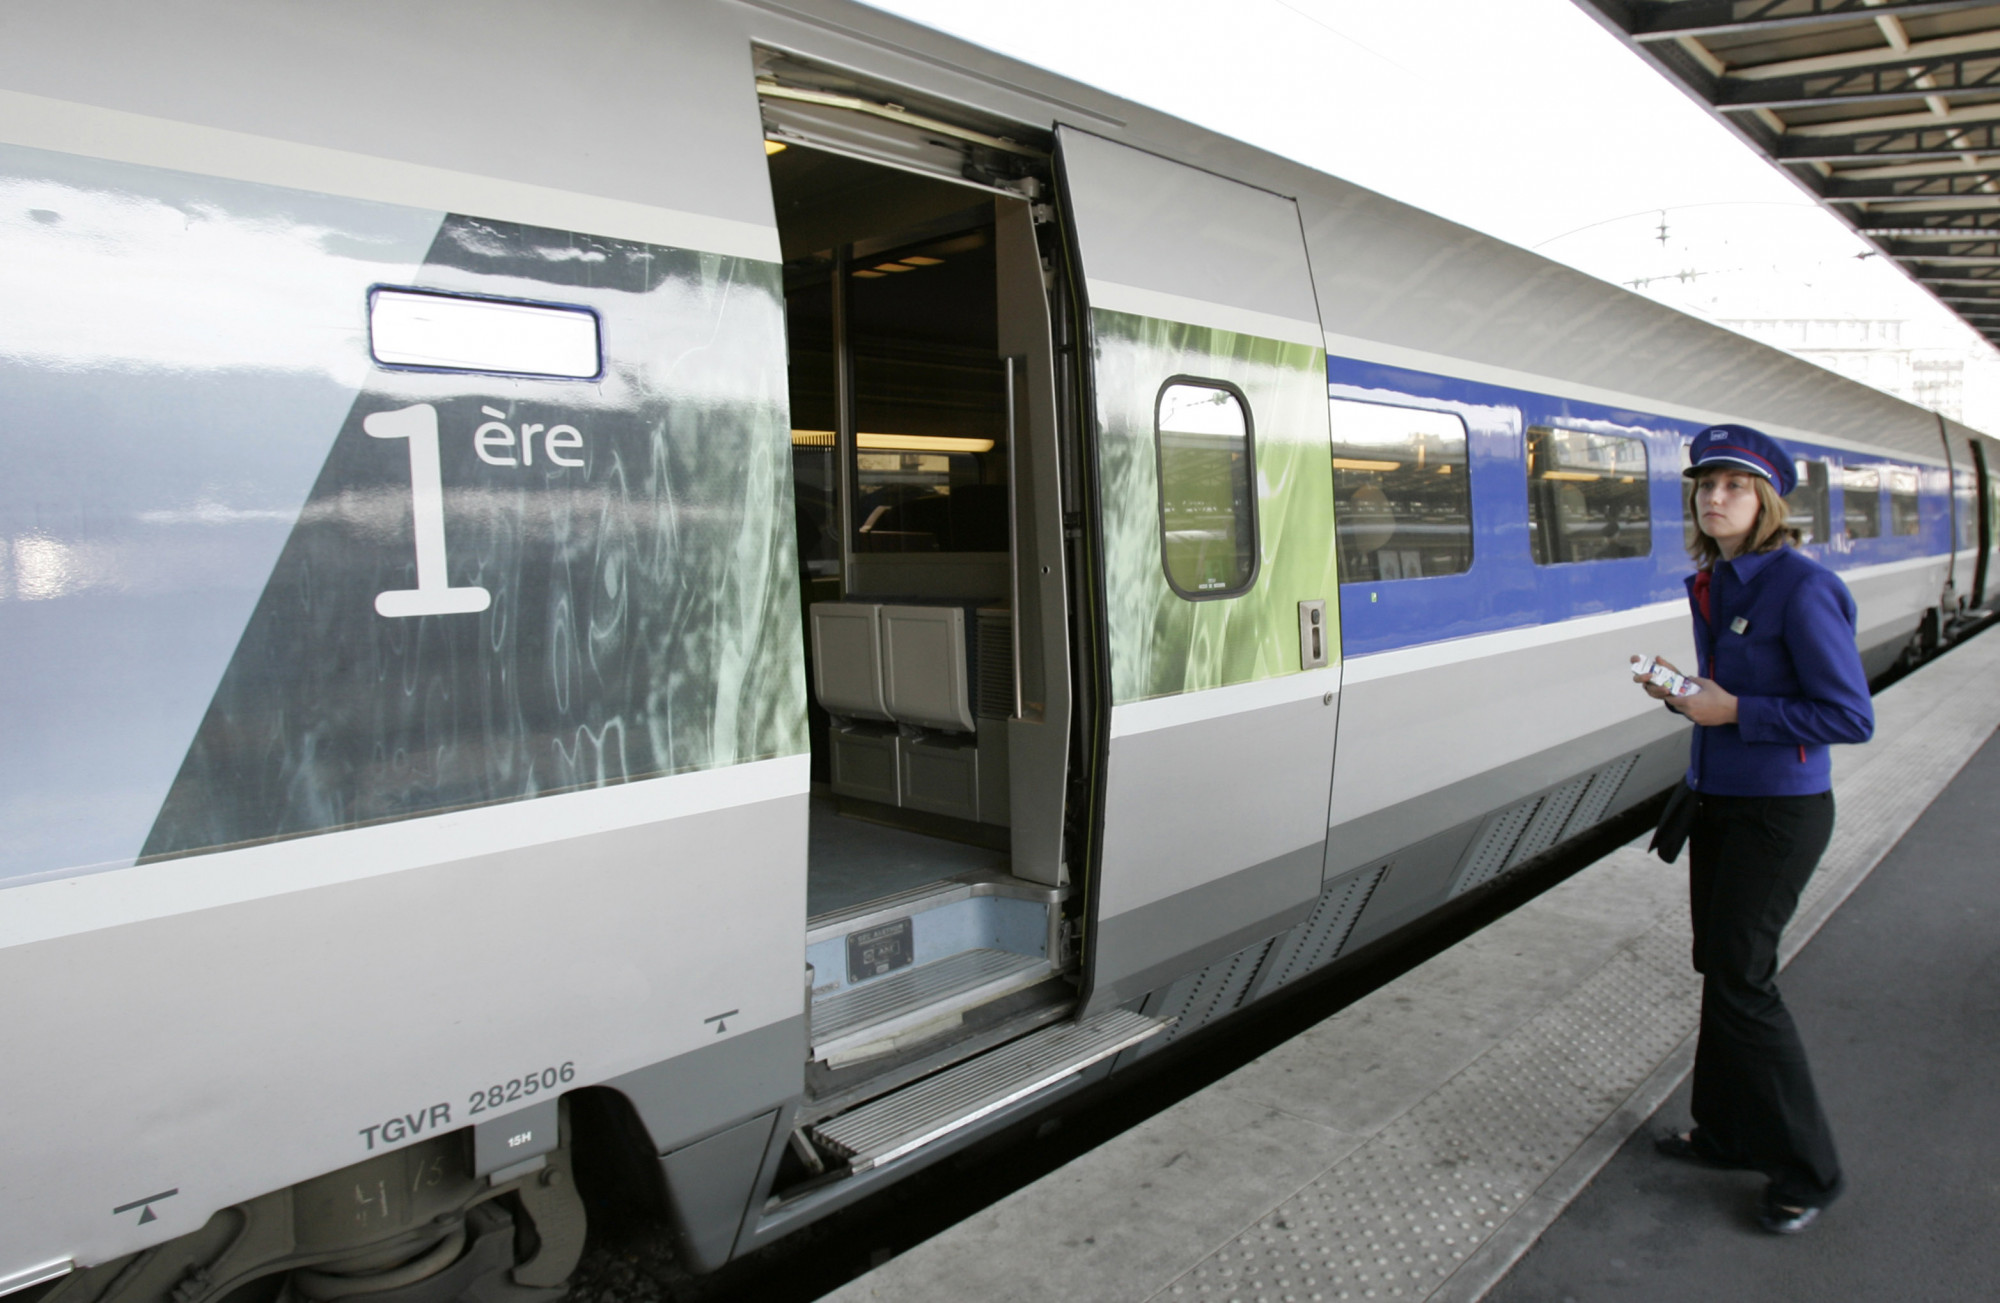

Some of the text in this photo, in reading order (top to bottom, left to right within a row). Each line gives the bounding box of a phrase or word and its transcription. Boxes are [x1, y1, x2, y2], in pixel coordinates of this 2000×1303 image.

[359, 1061, 576, 1150] TGVR 282506
[507, 1130, 532, 1148] 15H
